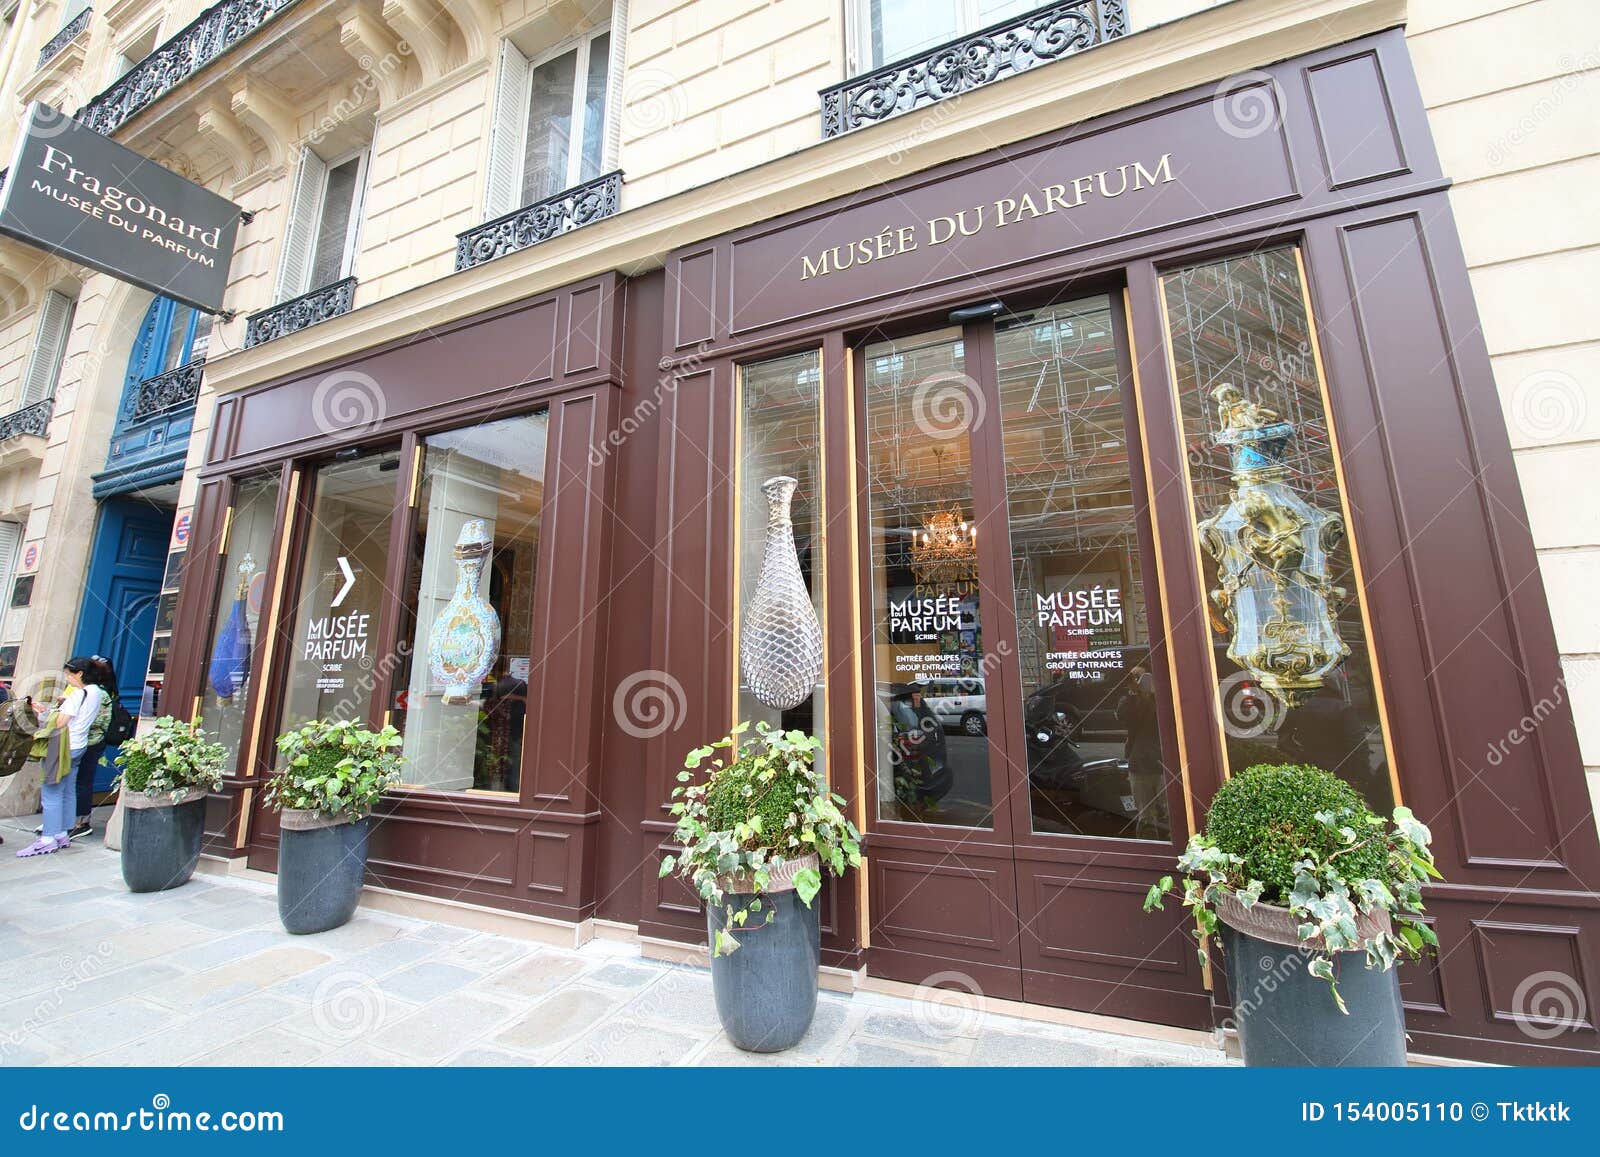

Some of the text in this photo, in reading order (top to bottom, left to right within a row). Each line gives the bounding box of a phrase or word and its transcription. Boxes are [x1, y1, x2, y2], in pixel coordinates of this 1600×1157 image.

[37, 144, 221, 249] Fragonard
[32, 179, 215, 268] MUSÉE DU PARFUM
[800, 153, 1177, 281] MUSÉE DU PARFUM
[890, 594, 960, 617] MUSÉE
[1036, 585, 1120, 610] MUSÉE
[307, 609, 370, 639] MUSÉE
[891, 615, 961, 632] PARFUM
[1038, 608, 1122, 627] PARFUM
[1067, 628, 1095, 636] SCRIBE
[304, 639, 367, 660] PARFUM
[896, 654, 960, 662] ENTRÉE GROUPES
[1046, 650, 1078, 660] ENTRÉE
[922, 663, 960, 671] ENTRANCE
[1077, 661, 1124, 669] ENTRANCE
